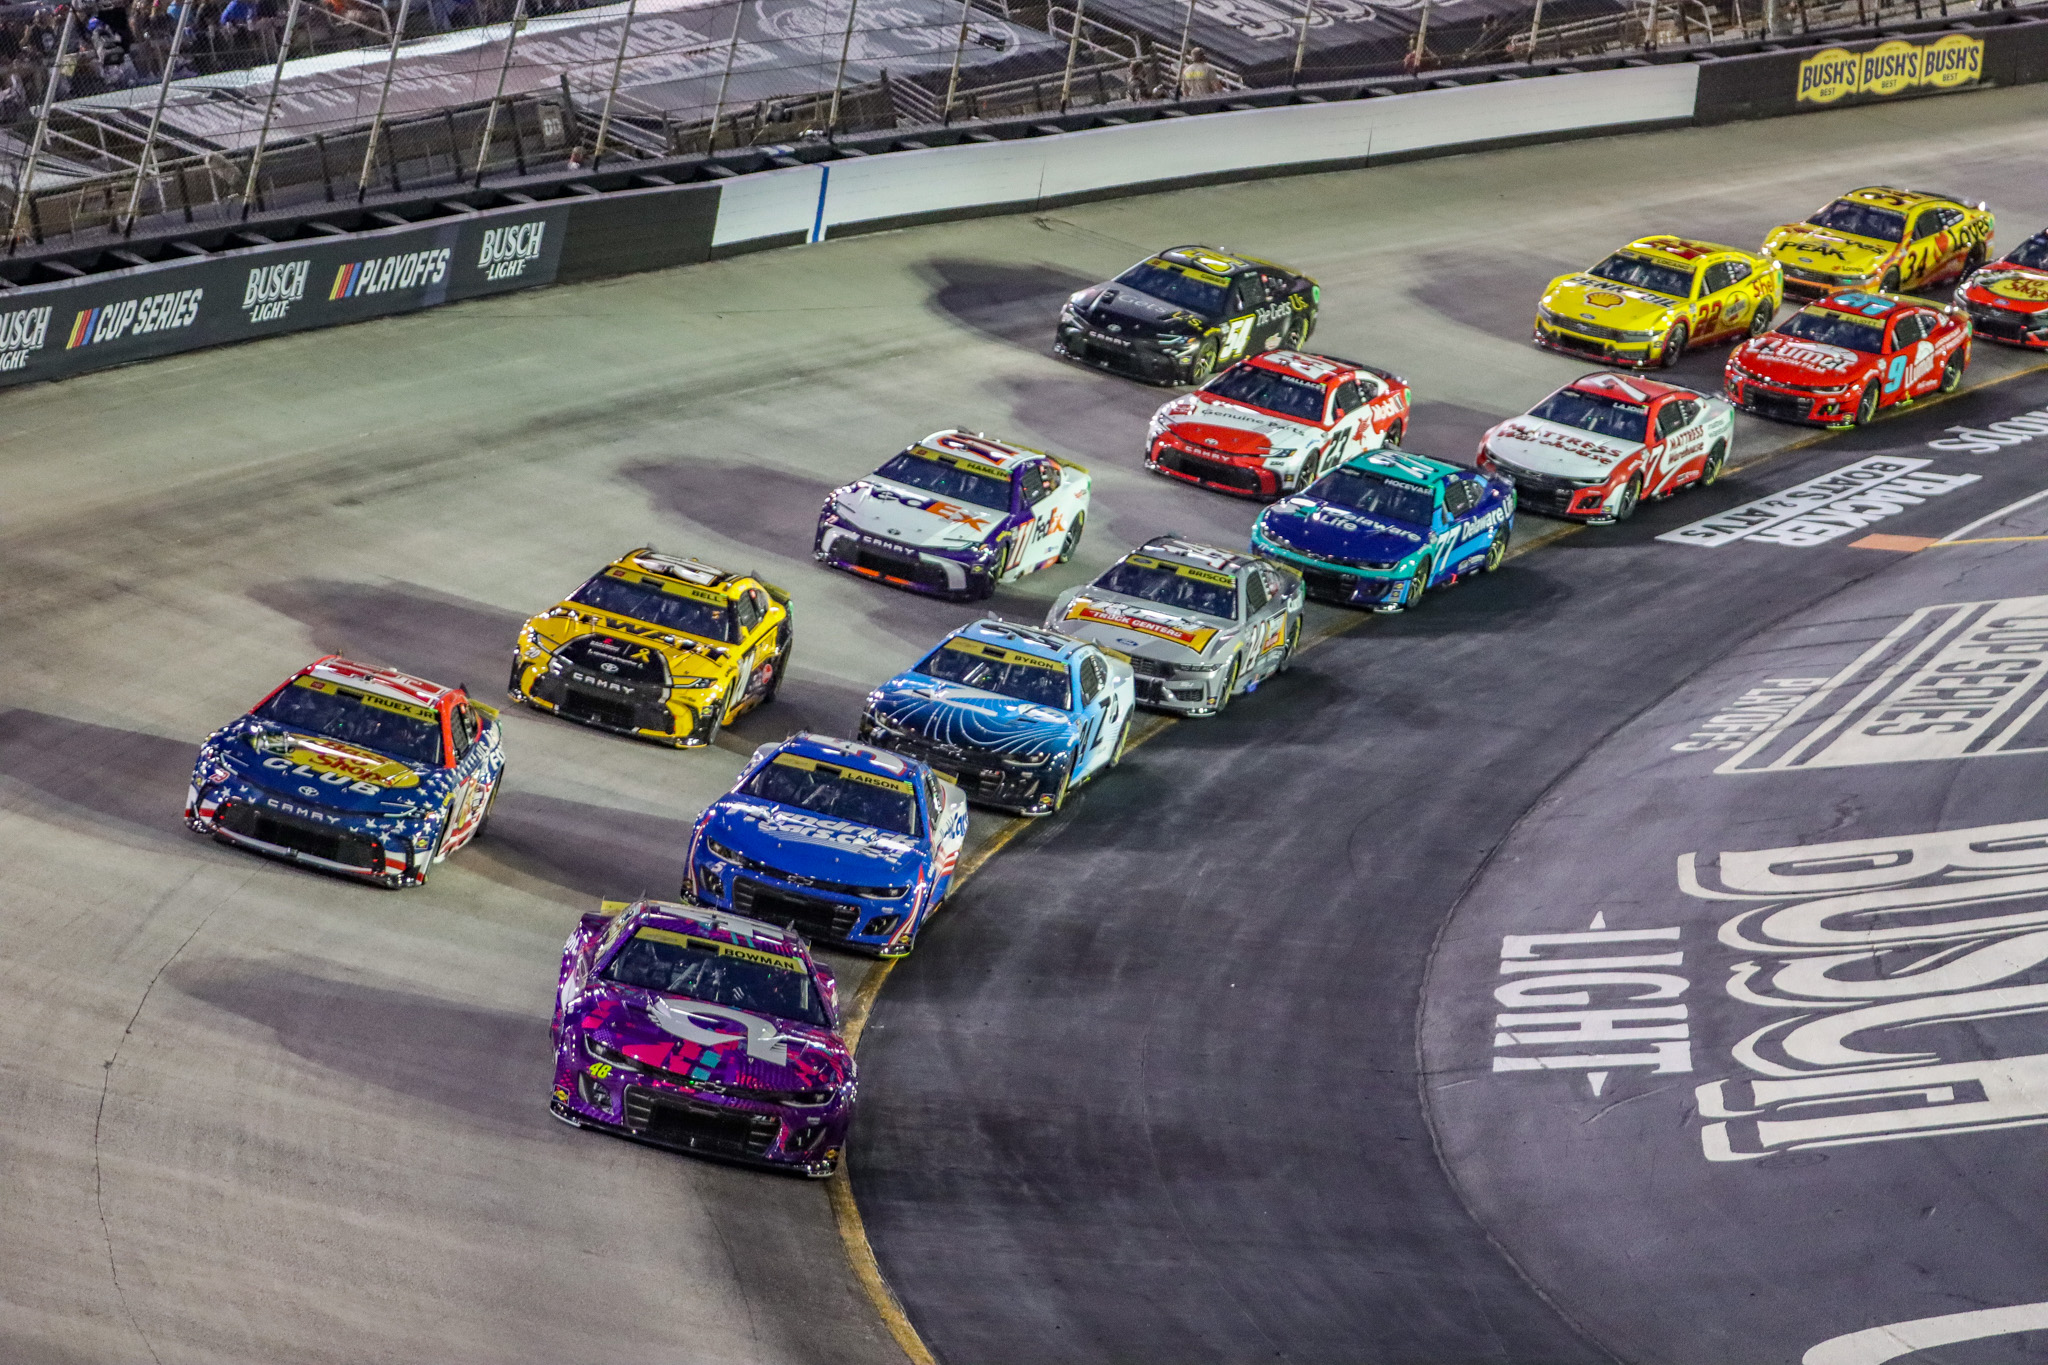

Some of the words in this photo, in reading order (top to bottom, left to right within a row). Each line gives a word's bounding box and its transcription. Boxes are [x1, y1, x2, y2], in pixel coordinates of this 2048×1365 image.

[508, 18, 711, 72] TRACKER
[1802, 60, 1856, 92] BUSH'S
[1863, 52, 1918, 85] BUSH'S
[1925, 46, 1980, 78] BUSH'S
[1881, 79, 1897, 89] BEST
[1942, 72, 1958, 82] BEST
[1820, 87, 1836, 97] BEST
[478, 222, 546, 268] BUSCH
[1778, 240, 1847, 262] PEAK
[355, 248, 450, 296] PLAYOFFS
[487, 259, 523, 281] LIGHT
[1903, 246, 1931, 282] 34
[242, 260, 311, 309] BUSCH
[93, 300, 138, 344] CUP
[132, 289, 203, 335] SERIES
[251, 301, 288, 323] LIGHT
[1090, 330, 1132, 347] CAMRY
[1217, 313, 1258, 362] 54
[0, 349, 28, 371] IGHT
[1884, 354, 1908, 394] 9
[1280, 375, 1323, 390] WALLACE
[1201, 408, 1264, 425] Genuine
[1267, 421, 1305, 437] Parts
[1926, 411, 2048, 454] hops
[1321, 426, 1353, 472] 23
[1508, 424, 1622, 457] MTTRESS
[1670, 425, 1704, 449] MATTRESS
[1184, 446, 1231, 463] CAMRY
[966, 462, 1009, 479] HAMLIN
[1787, 461, 1907, 500] BOATS
[1384, 478, 1434, 494] HOCEVAR
[1318, 515, 1358, 532] Life
[1744, 472, 1983, 547] TRACKER
[1462, 505, 1504, 544] Delaware
[862, 536, 915, 556] CAMRY
[1431, 525, 1462, 574] 77
[1187, 569, 1236, 585] BRISCOE
[691, 589, 722, 603] BELL
[1089, 610, 1130, 624] TRUCK
[1131, 619, 1183, 638] CENTERS
[1013, 654, 1055, 671] BYRON
[572, 671, 636, 695] CAMRY
[1861, 657, 2043, 736] SERIES
[366, 694, 412, 713] TRUEX
[416, 707, 435, 720] JR
[1670, 676, 1833, 752] PLAYOFFS
[262, 757, 381, 796] CLUB
[847, 772, 900, 791] LARSON
[267, 798, 341, 824] CAMRY
[726, 801, 921, 848] endrick
[724, 948, 796, 971] BOWMAN
[1493, 926, 1695, 1074] LIGHT
[589, 1062, 612, 1079] 48
